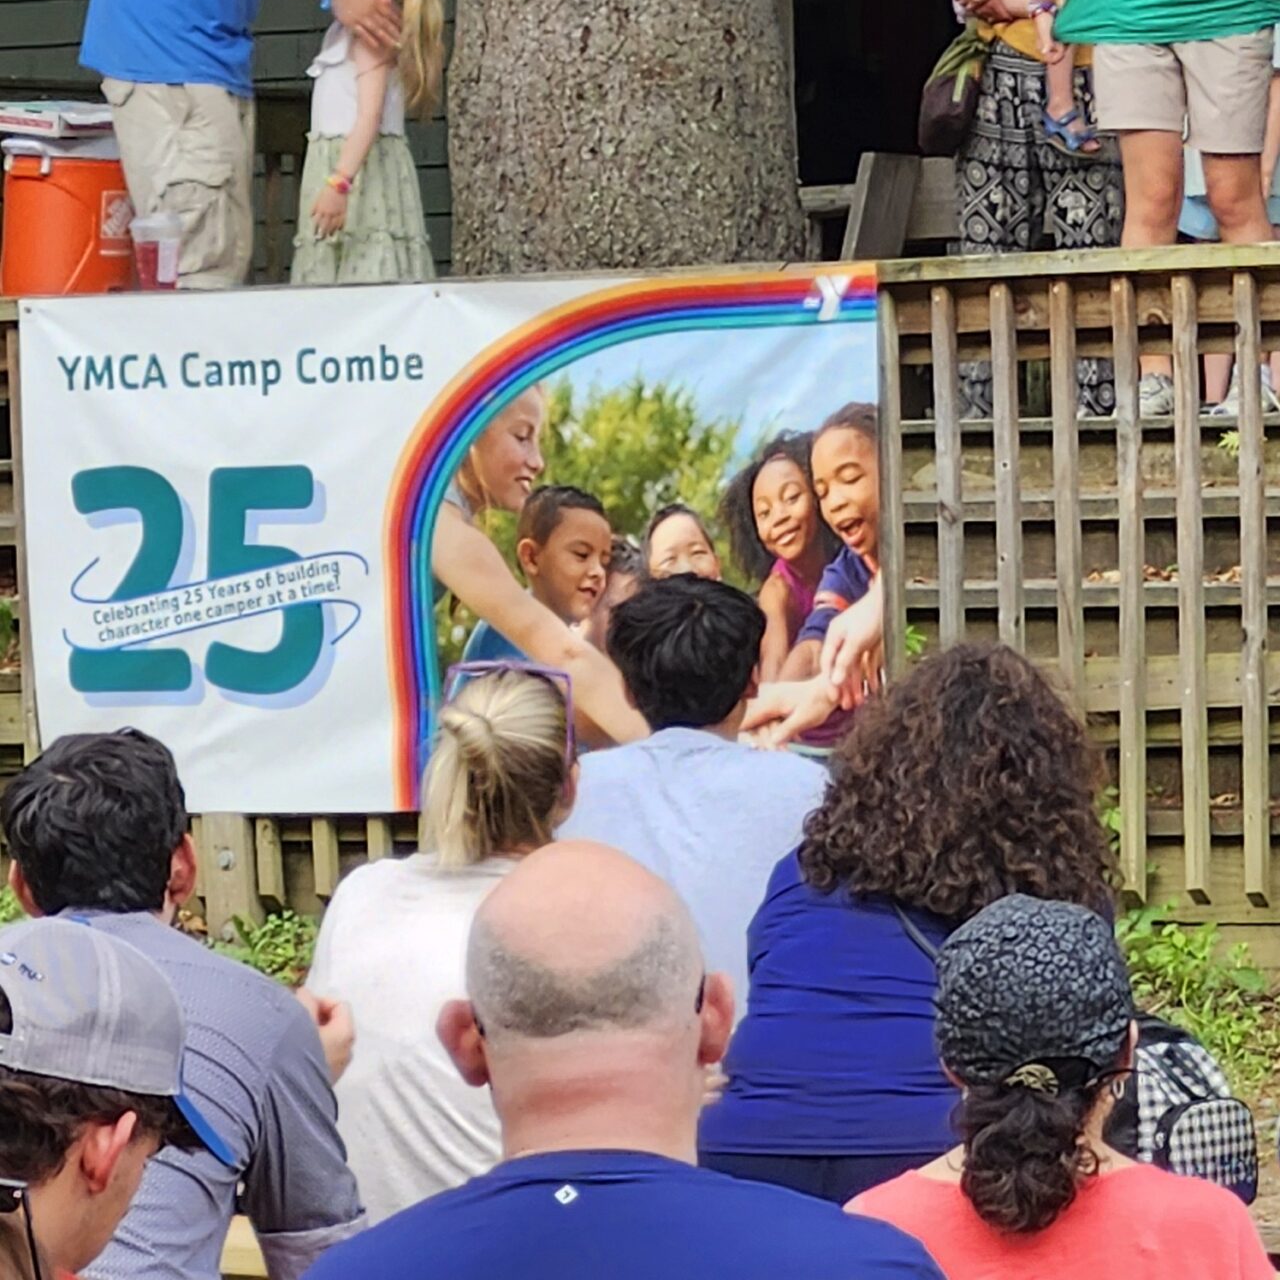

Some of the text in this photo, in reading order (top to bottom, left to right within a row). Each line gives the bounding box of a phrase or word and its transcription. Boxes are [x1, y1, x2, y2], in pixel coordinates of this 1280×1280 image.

[57, 344, 424, 397] YMCA Camp Combe
[69, 464, 324, 696] 25
[93, 561, 340, 625] Celebrating 25 Years of building
[98, 574, 341, 642] character one camper at a time!
